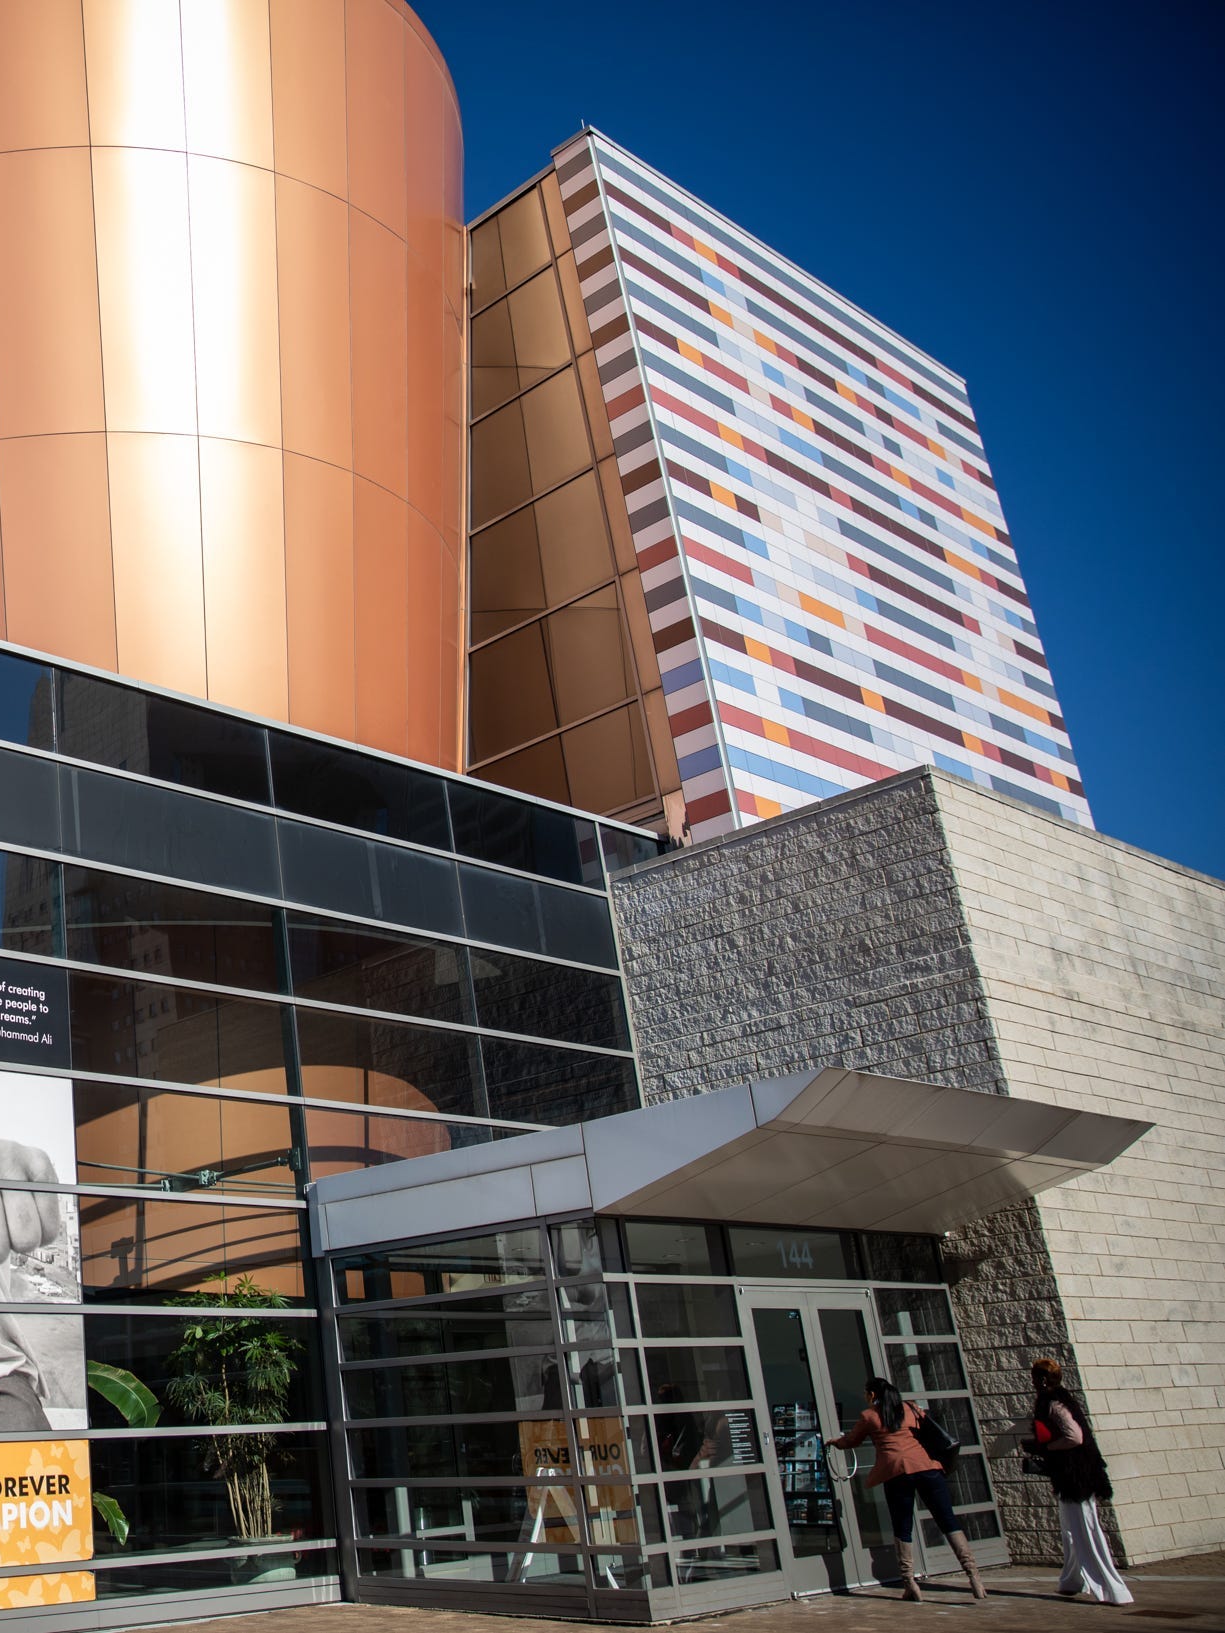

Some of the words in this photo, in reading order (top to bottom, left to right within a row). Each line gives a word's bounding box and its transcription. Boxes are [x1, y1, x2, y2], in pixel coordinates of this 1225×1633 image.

[8, 987, 45, 1001] creating
[5, 1000, 37, 1012] people
[39, 1003, 49, 1014] to
[41, 1033, 52, 1045] Ali
[776, 1240, 813, 1269] 144
